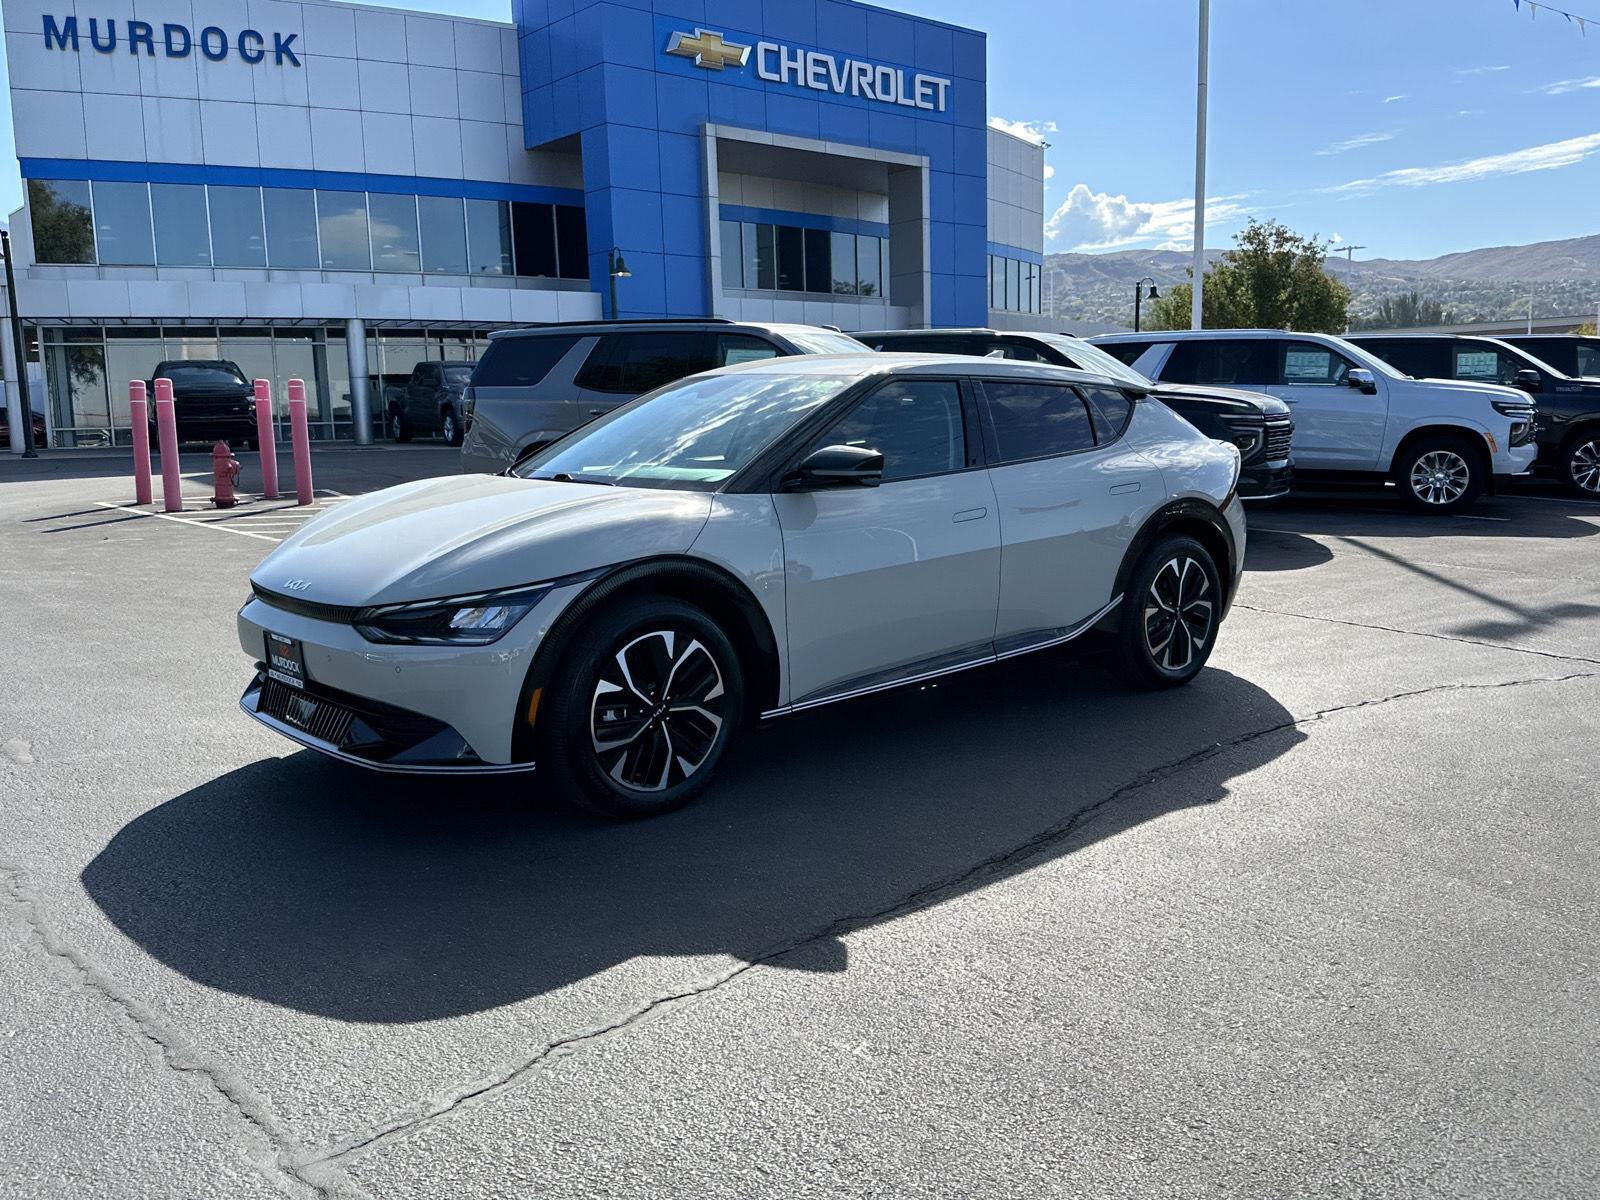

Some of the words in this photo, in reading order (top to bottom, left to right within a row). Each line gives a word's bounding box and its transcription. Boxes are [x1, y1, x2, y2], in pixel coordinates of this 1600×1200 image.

[42, 14, 301, 67] MURDOCK
[756, 41, 951, 112] CHEVROLET
[283, 579, 312, 591] KIA
[271, 654, 301, 674] MURDOCK
